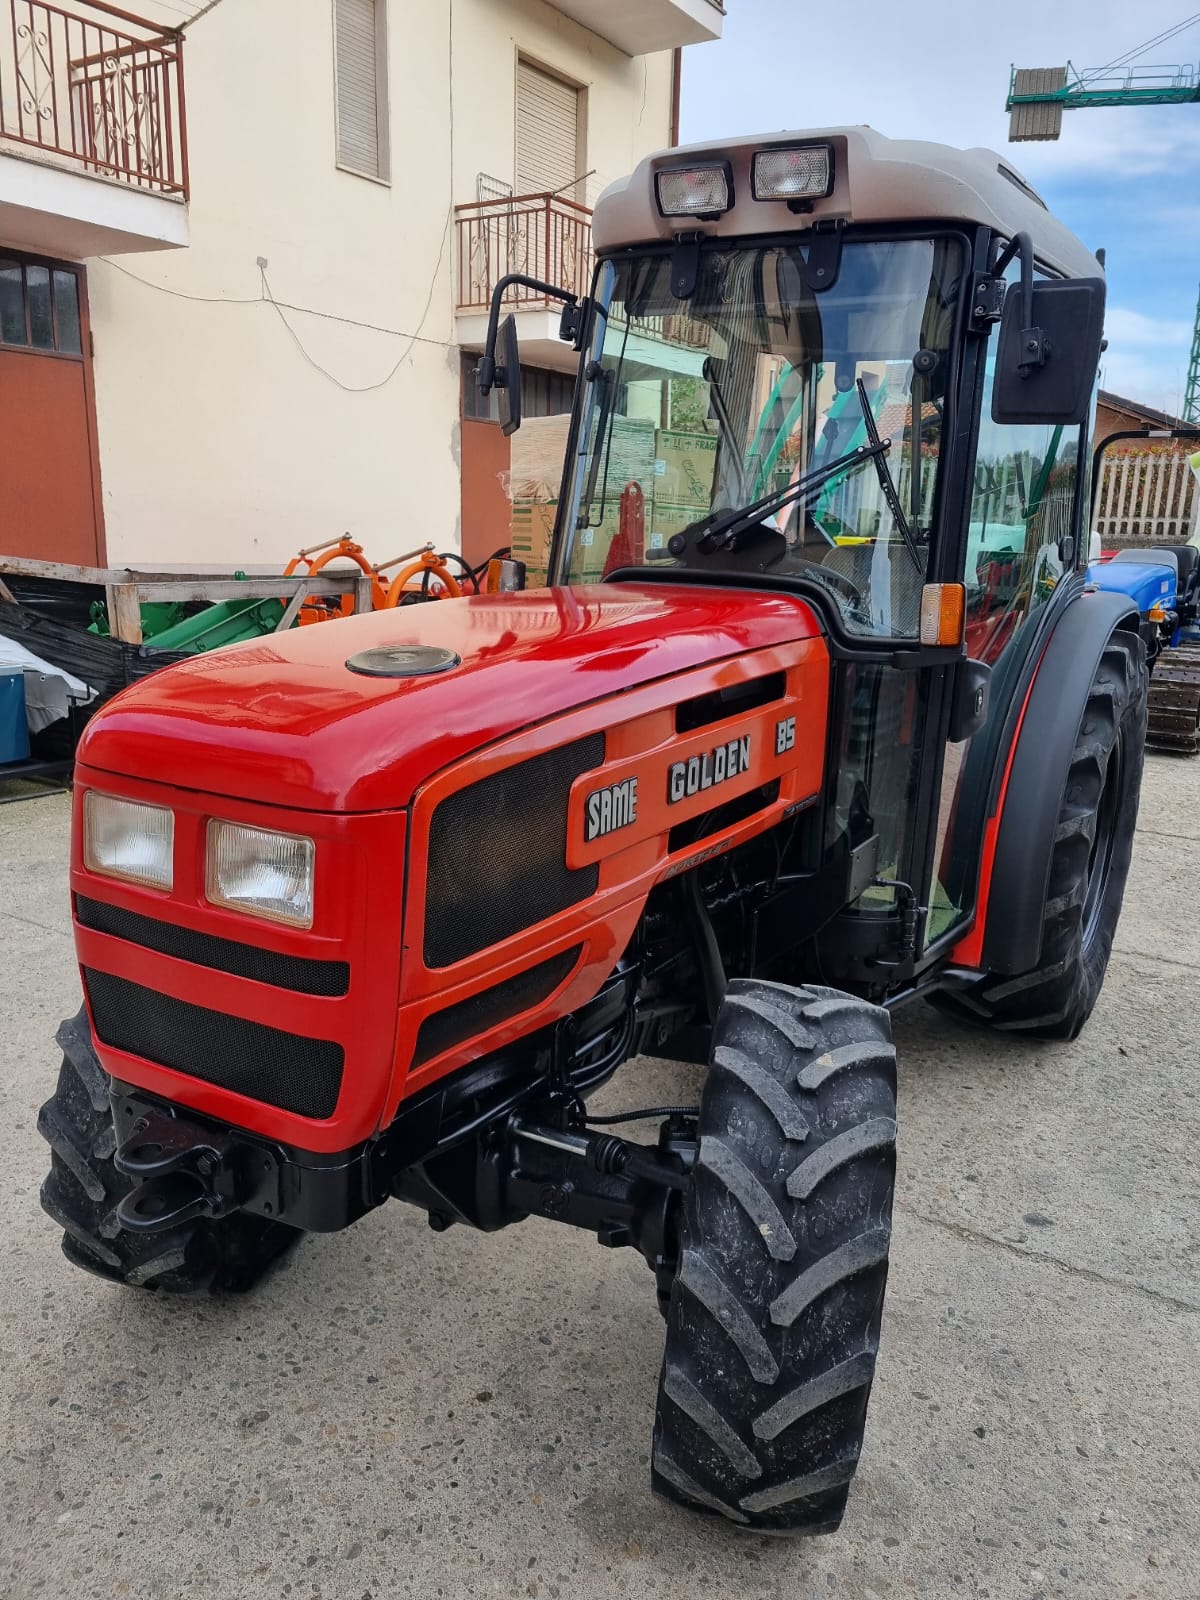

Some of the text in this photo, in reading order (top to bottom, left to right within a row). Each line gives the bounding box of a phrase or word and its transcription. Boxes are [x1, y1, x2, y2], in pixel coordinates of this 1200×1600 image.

[585, 717, 796, 842] SAME GOLDEN 85
